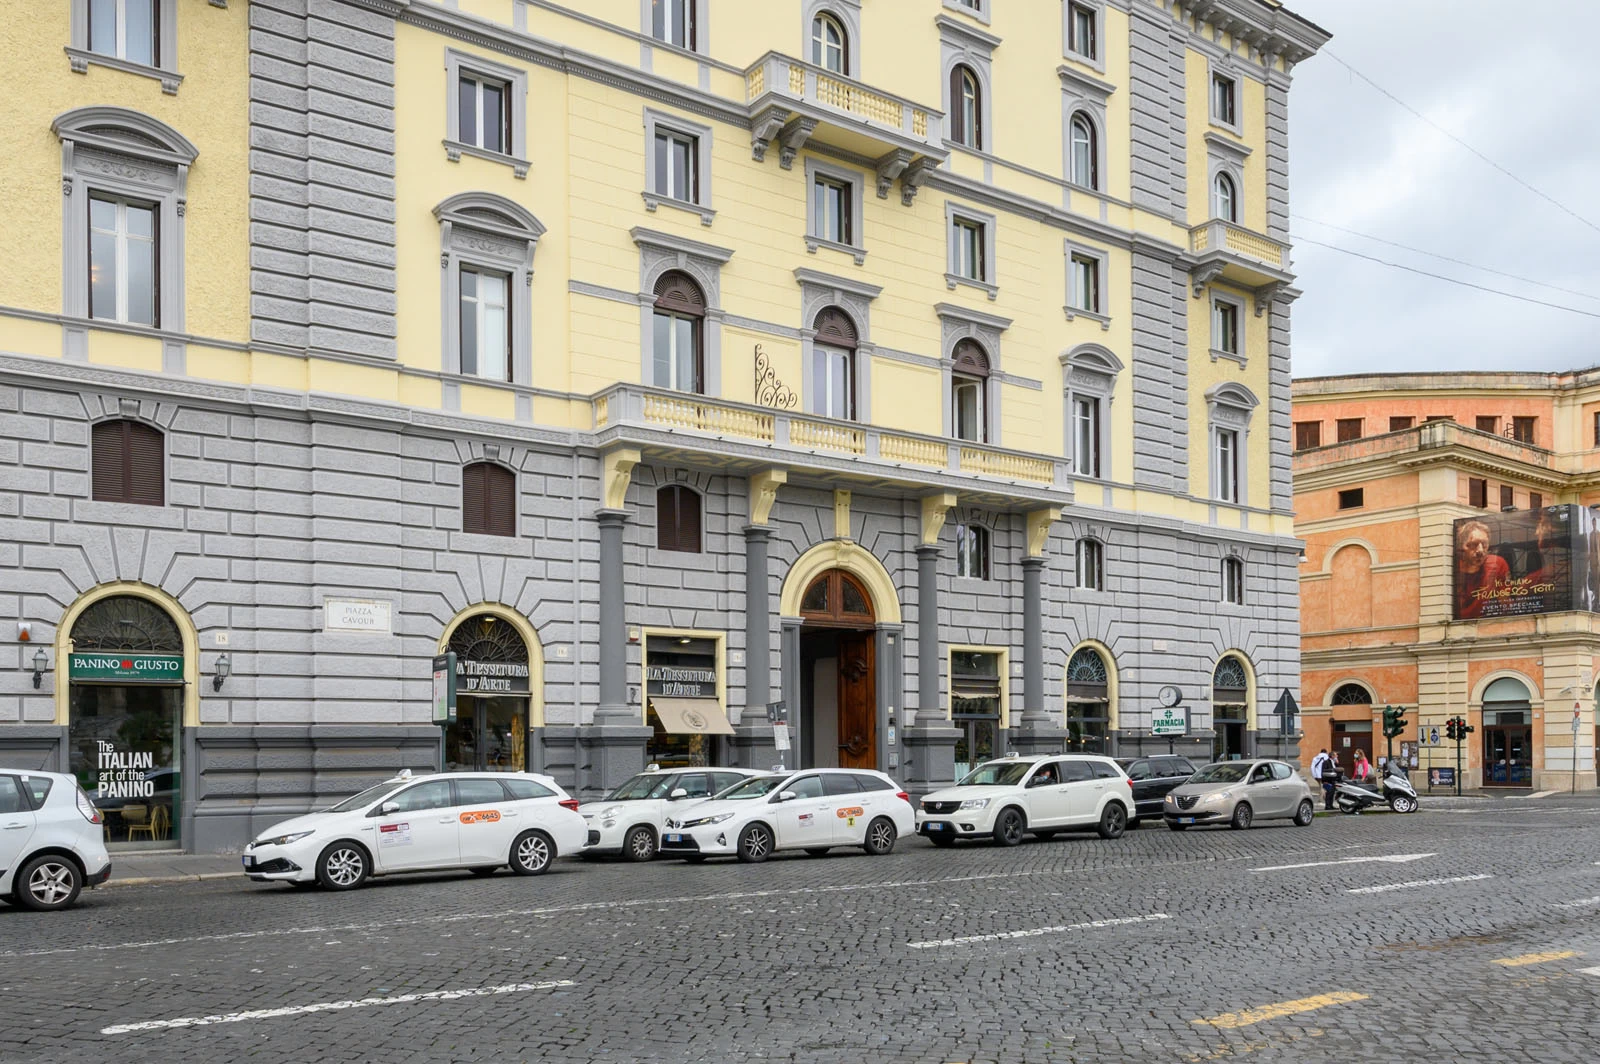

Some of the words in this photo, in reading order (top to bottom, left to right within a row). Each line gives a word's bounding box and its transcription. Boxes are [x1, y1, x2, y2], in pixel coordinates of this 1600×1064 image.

[74, 659, 120, 669] PANINO
[134, 660, 179, 671] GIUSTO
[465, 660, 529, 678] TESSITURA
[97, 740, 114, 752] The
[98, 752, 153, 769] ITALIAN
[99, 769, 114, 781] art
[115, 768, 127, 781] of
[128, 769, 145, 781] the
[98, 781, 154, 798] PANINO
